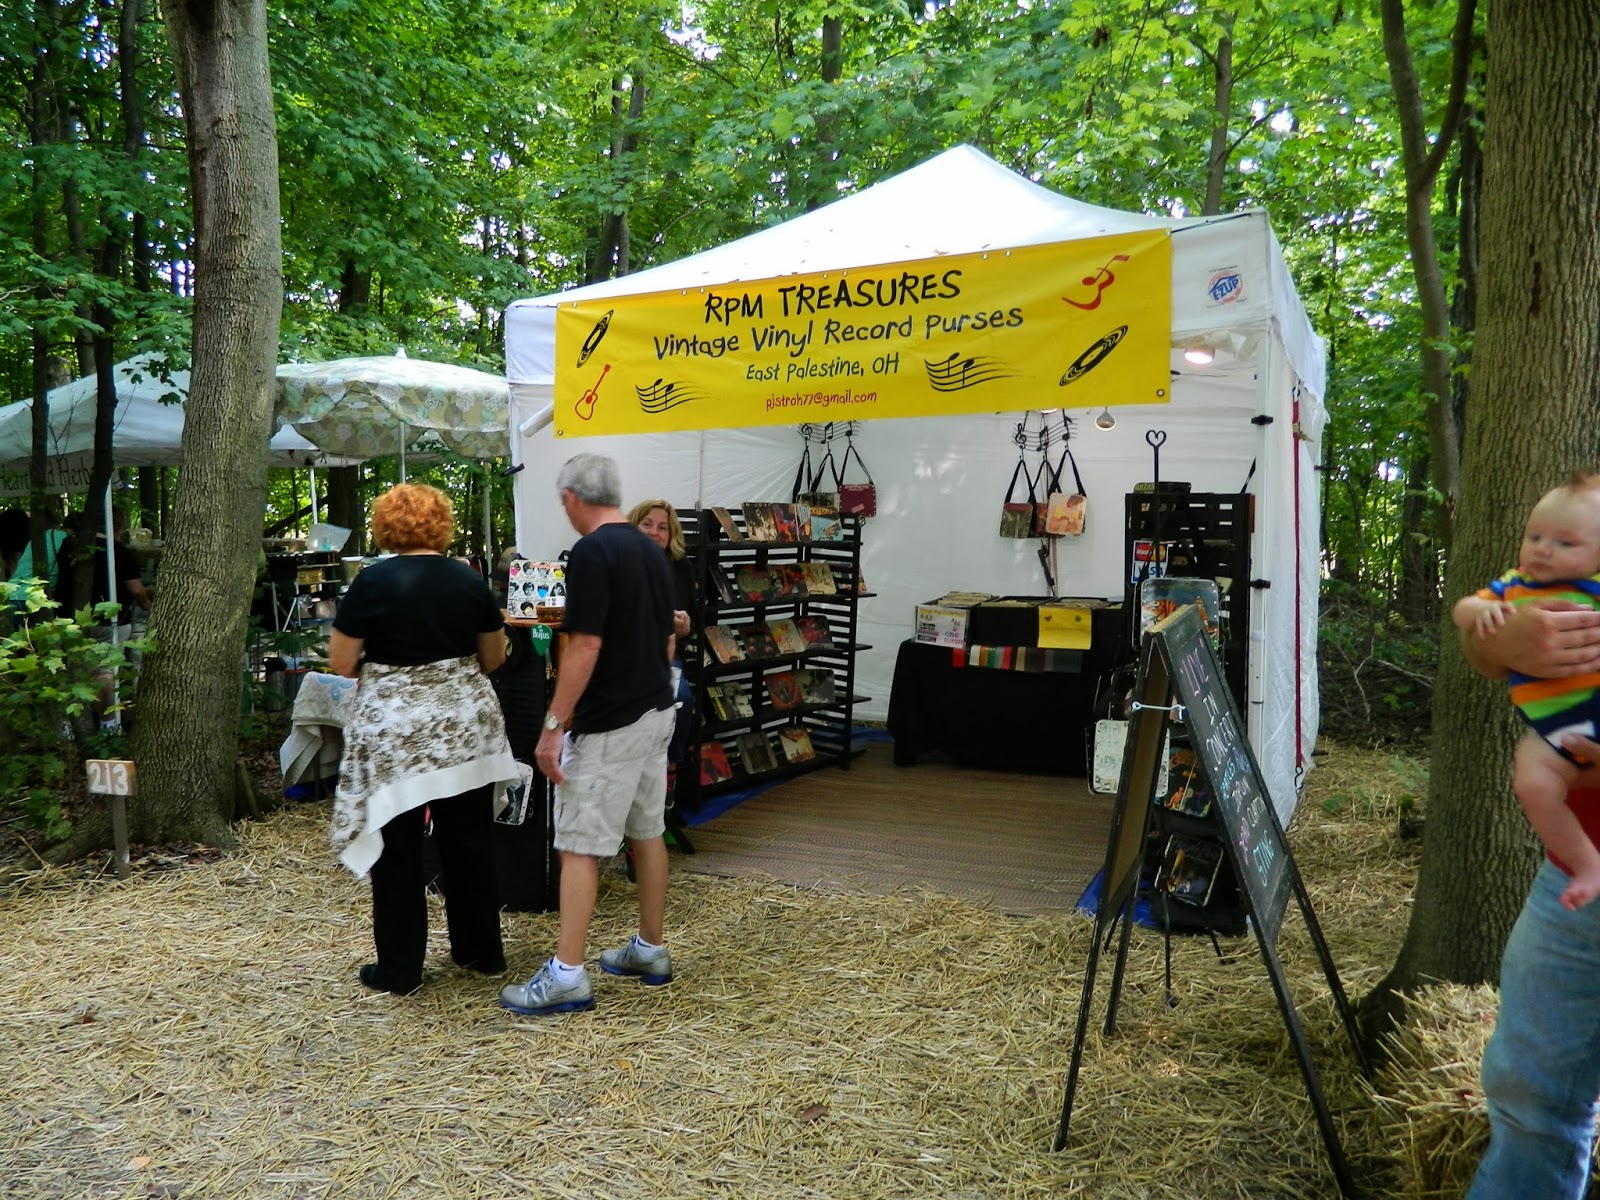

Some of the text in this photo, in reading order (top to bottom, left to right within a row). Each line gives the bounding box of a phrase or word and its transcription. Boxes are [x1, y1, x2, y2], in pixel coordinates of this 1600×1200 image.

[704, 269, 963, 326] RPM TREASURES
[653, 333, 740, 361] Vintage
[751, 320, 814, 358] Vinyl
[824, 314, 912, 345] Record
[746, 352, 900, 383] East Palestine, OH
[766, 388, 877, 412] pjstroh77@gmail.com
[1202, 690, 1220, 726] IN
[87, 762, 129, 796] 213
